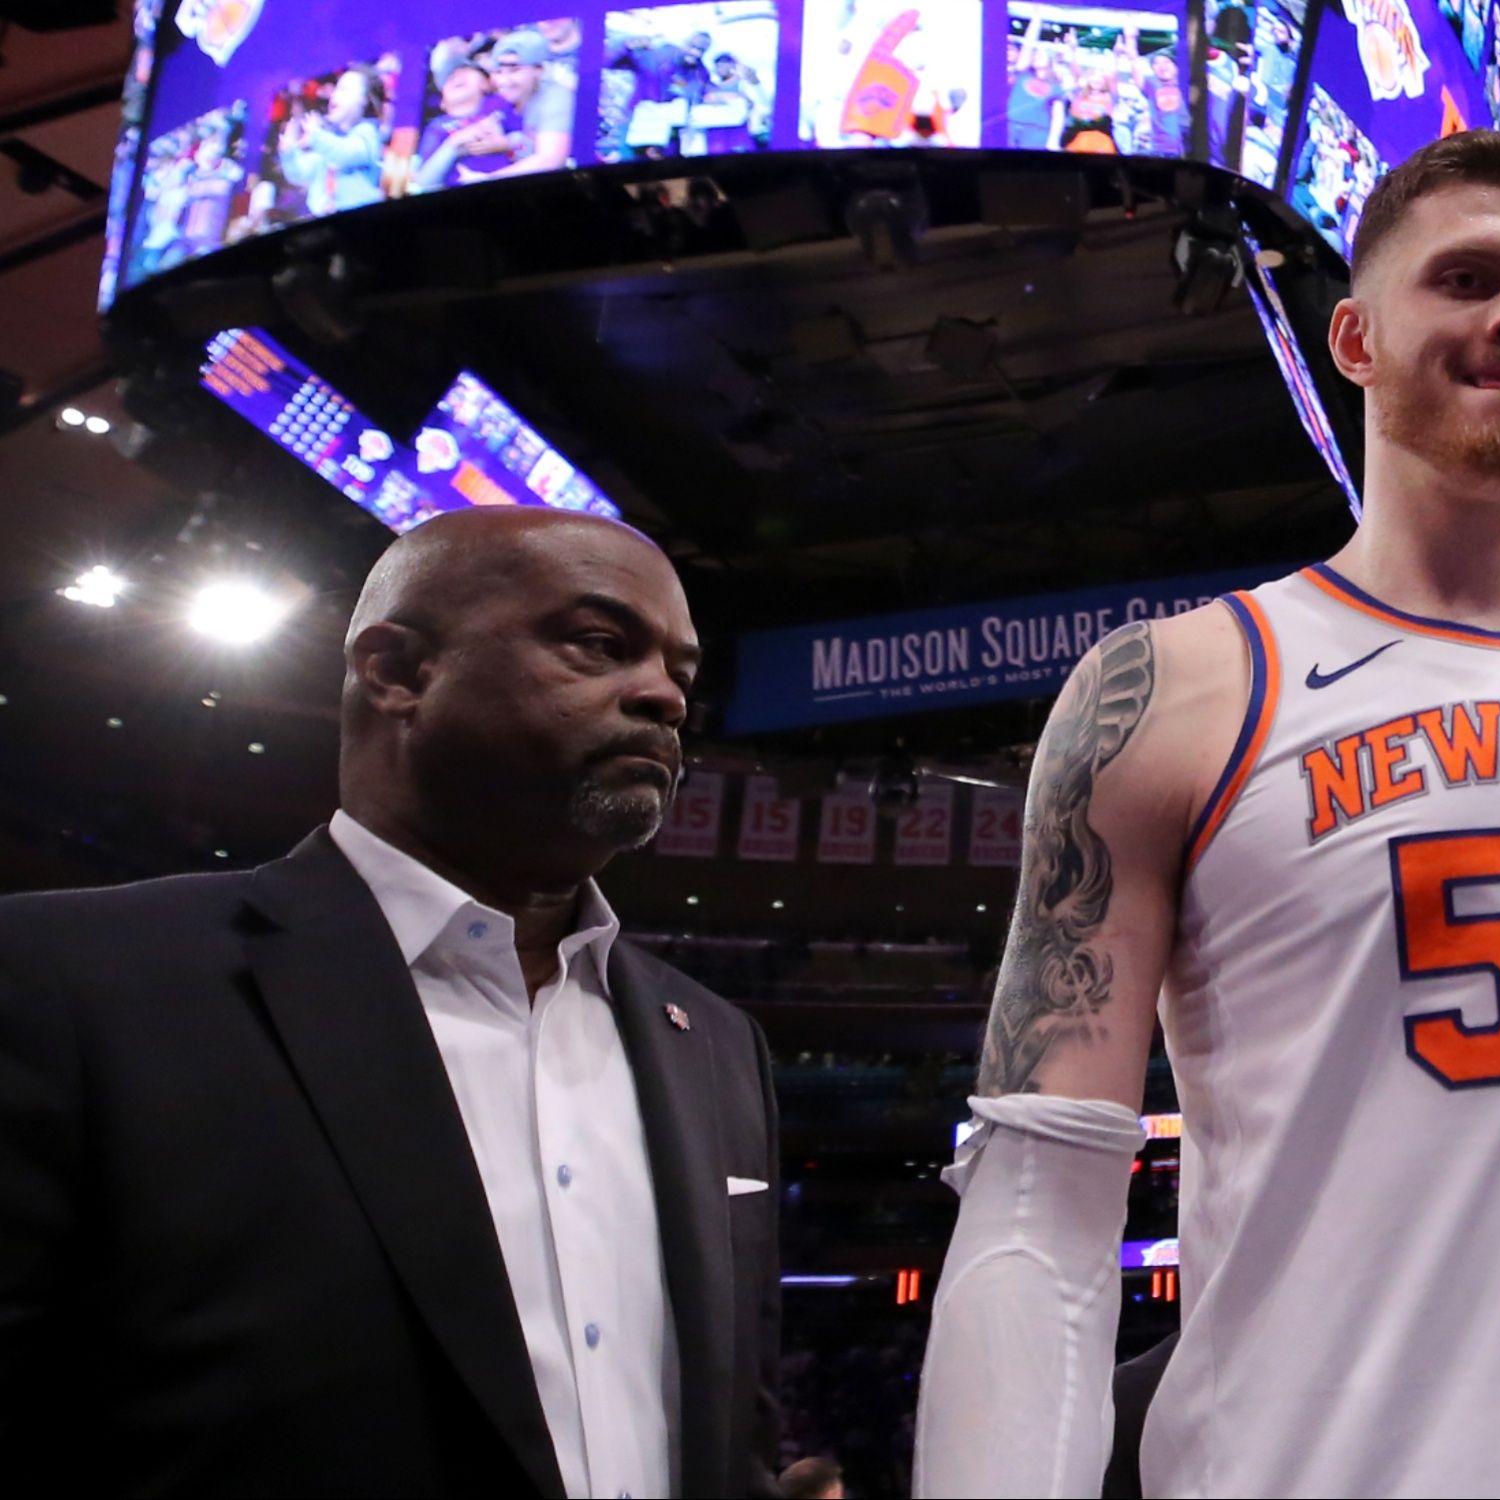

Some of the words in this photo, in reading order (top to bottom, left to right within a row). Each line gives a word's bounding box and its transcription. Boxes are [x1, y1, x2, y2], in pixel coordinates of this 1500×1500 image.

[879, 688, 913, 699] THE
[920, 674, 998, 695] WORLD'S
[1004, 667, 1052, 684] MOST
[751, 800, 790, 833] 15
[829, 805, 867, 837] 19
[901, 808, 947, 839] 22
[975, 808, 1018, 840] 24
